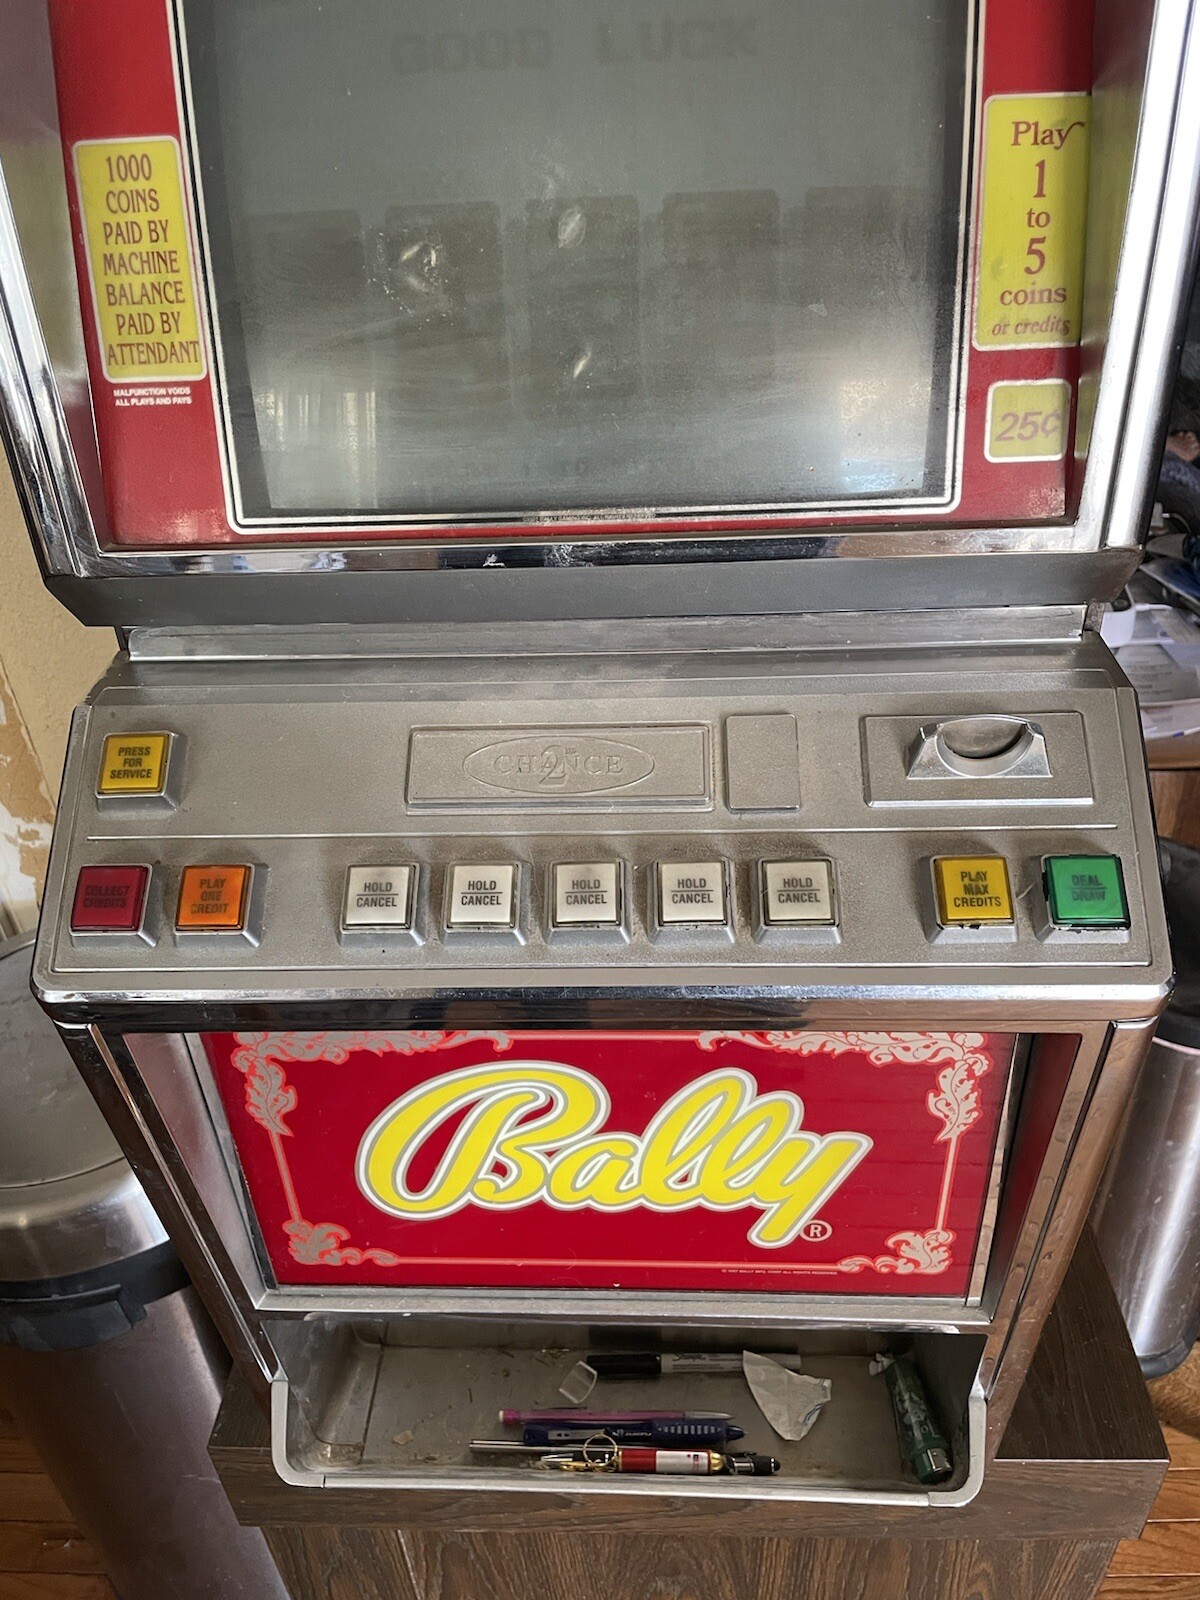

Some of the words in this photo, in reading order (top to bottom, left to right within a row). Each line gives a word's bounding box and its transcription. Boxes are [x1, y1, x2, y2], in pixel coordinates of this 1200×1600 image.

[596, 17, 760, 66] LUCK
[1011, 121, 1085, 150] Play
[105, 153, 152, 184] 1000
[1033, 159, 1047, 199] 1
[105, 188, 160, 214] COINS
[1026, 207, 1052, 229] to
[103, 220, 143, 246] PAID
[147, 219, 169, 244] BY
[1023, 236, 1047, 275] 5
[103, 250, 180, 276] MACHINE
[104, 281, 186, 307] BALANCE
[1000, 281, 1067, 306] coins
[115, 312, 155, 336] PAID
[159, 311, 182, 335] BY
[991, 320, 1011, 336] or
[1013, 315, 1071, 336] credits
[106, 340, 200, 366] ATTENDANT
[113, 387, 167, 397] MALFUNCTION
[167, 386, 191, 396] VOIDS
[115, 398, 130, 407] ALL
[130, 397, 155, 406] PLAYS
[155, 396, 172, 405] AND
[172, 395, 193, 405] PAYS
[994, 409, 1063, 443] 25¢
[117, 746, 151, 757] PRESS
[123, 757, 143, 768] FOR
[493, 753, 625, 776] CHANCE
[110, 768, 153, 780] SERVICE
[959, 870, 988, 883] PLAY
[198, 878, 227, 890] PLAY
[363, 882, 393, 893] HOLD
[467, 880, 497, 891] HOLD
[572, 879, 601, 890] HOLD
[677, 878, 707, 889] HOLD
[783, 877, 813, 889] HOLD
[962, 883, 990, 896] MAX
[200, 890, 223, 902] ONE
[460, 895, 502, 906] CANCEL
[565, 894, 608, 905] CANCEL
[671, 892, 714, 904] CANCEL
[777, 892, 821, 904] CANCEL
[953, 896, 1002, 908] CREDITS
[356, 897, 398, 908] CANCEL
[190, 903, 230, 915] CREDIT
[354, 1059, 875, 1249] Bally
